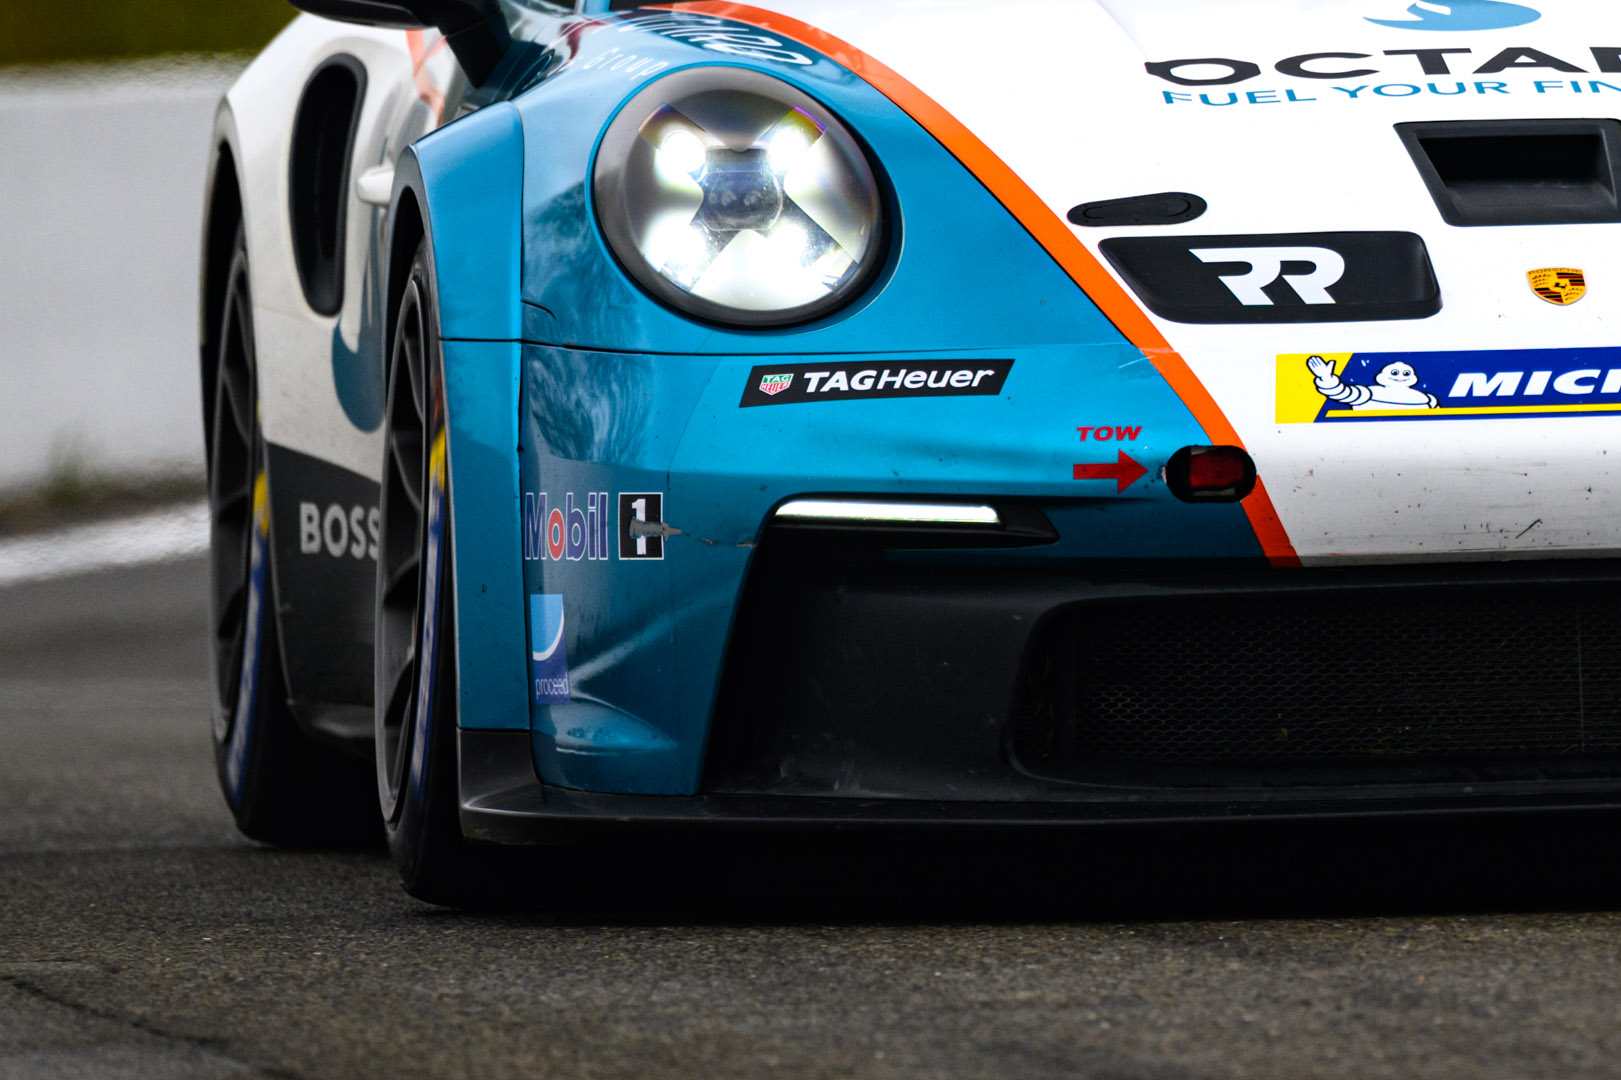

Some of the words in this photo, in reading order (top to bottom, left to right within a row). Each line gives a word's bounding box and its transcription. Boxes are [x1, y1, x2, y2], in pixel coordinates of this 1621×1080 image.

[1162, 89, 1317, 107] FUEL
[1330, 81, 1511, 98] YOUR
[1188, 246, 1345, 306] RR
[763, 374, 791, 383] TAG
[1077, 426, 1142, 442] TOW
[525, 492, 608, 561] Mobil
[536, 675, 569, 700] proceed
